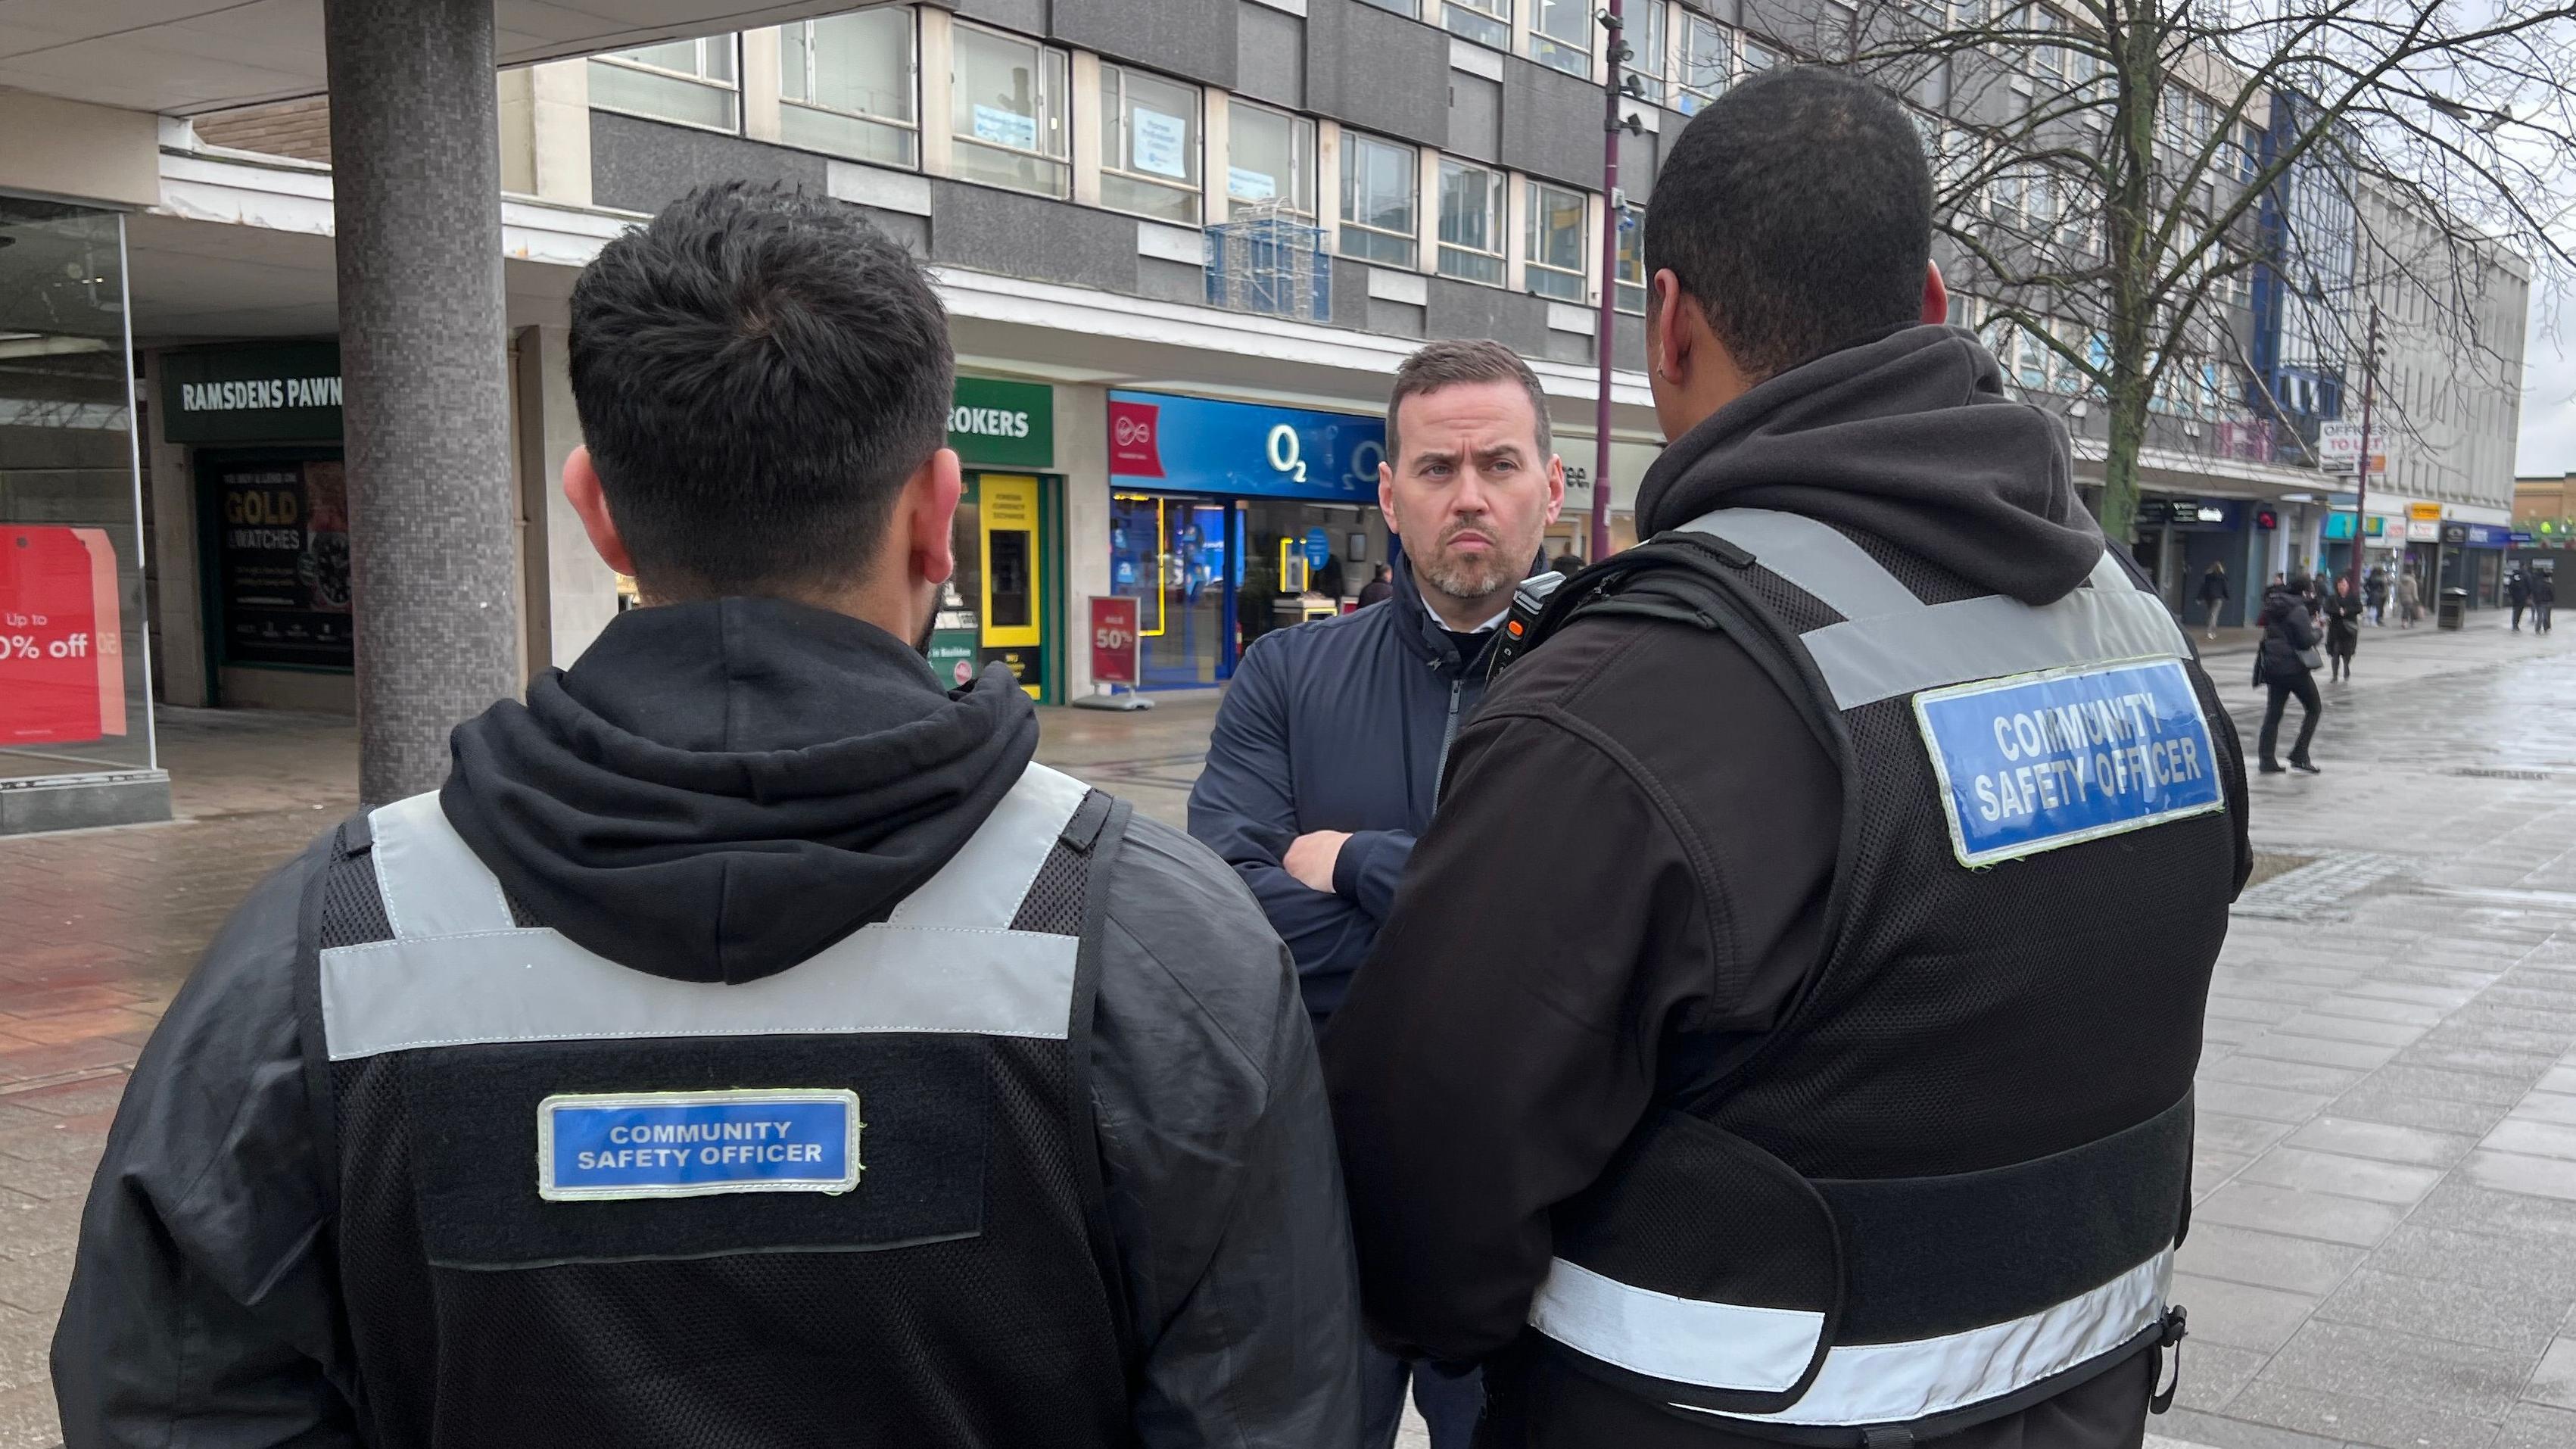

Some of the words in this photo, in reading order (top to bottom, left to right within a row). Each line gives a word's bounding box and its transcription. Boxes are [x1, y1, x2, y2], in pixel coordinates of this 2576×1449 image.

[182, 379, 285, 410] RAMSDENS
[287, 377, 343, 407] PAWN
[1267, 423, 1307, 483] O2
[2328, 438, 2349, 450] TO
[2353, 437, 2382, 450] LT
[226, 491, 297, 525] GOLD
[235, 530, 300, 550] WATCHES
[6, 612, 27, 628] Up
[32, 614, 48, 626] to
[49, 633, 88, 658] off
[1994, 693, 2161, 761] COMMUNITY
[1975, 756, 2086, 821] SAFETY
[2095, 737, 2202, 797] OFFICER
[610, 1121, 792, 1144] COMMUNITY
[578, 1148, 690, 1170] SAFETY
[700, 1144, 823, 1164] OFFICER
